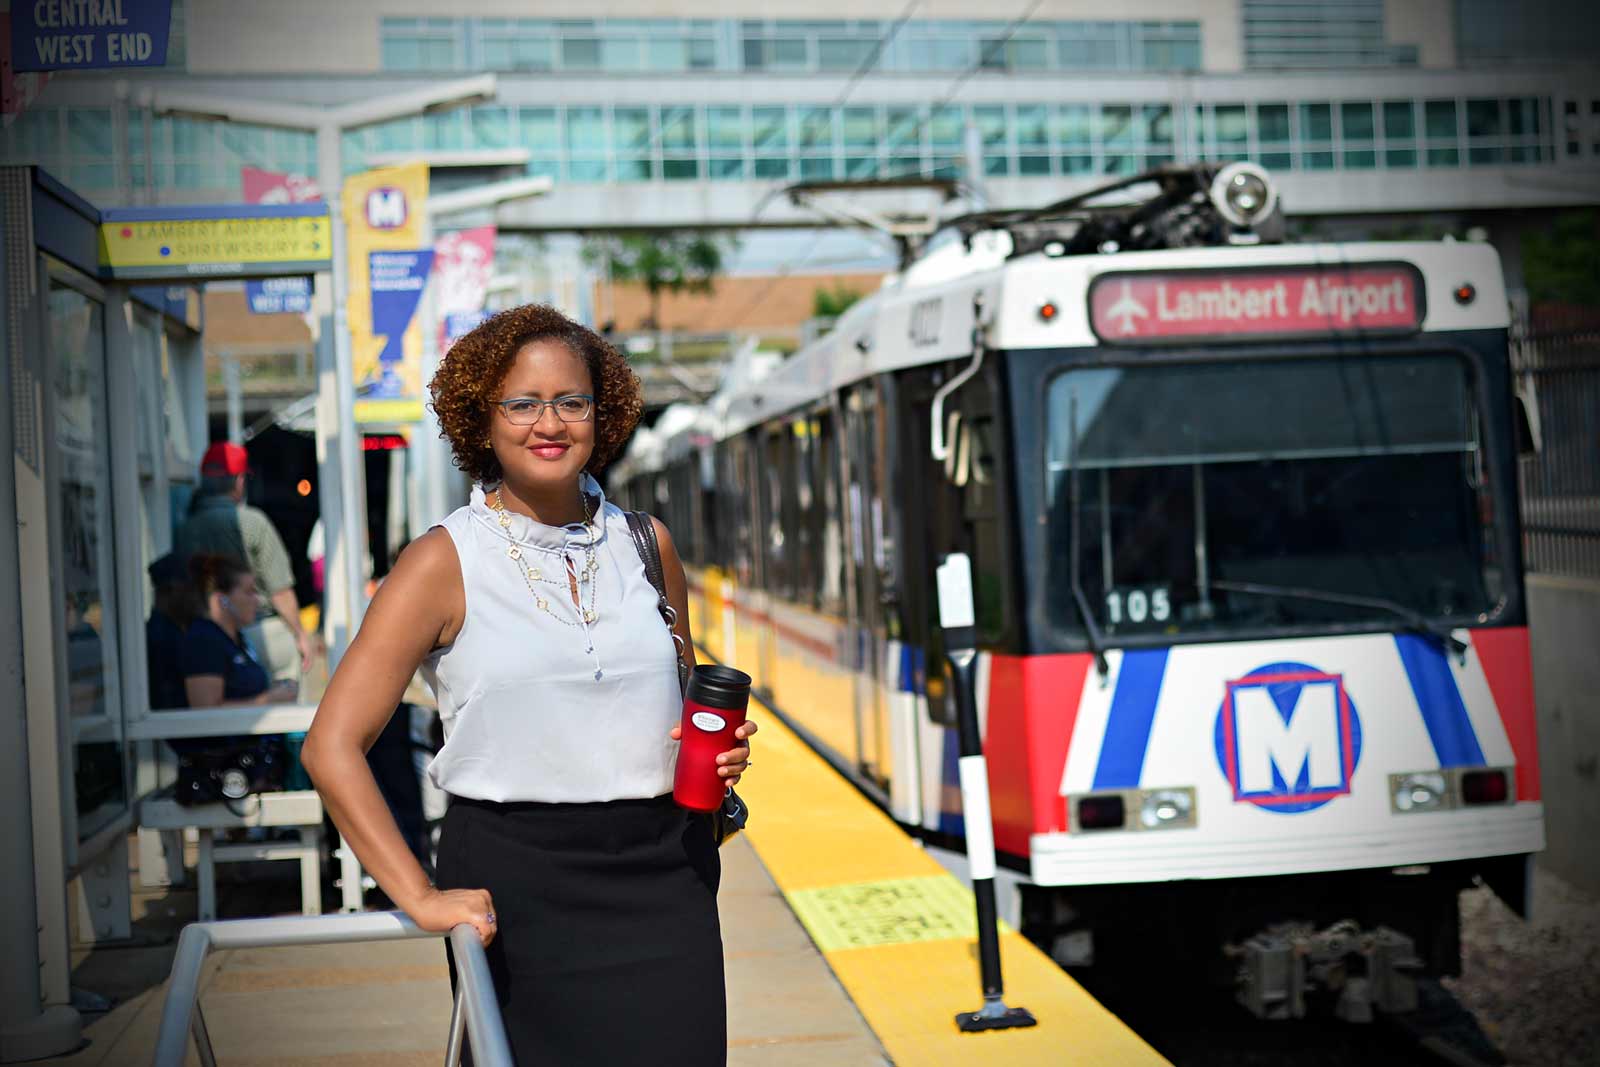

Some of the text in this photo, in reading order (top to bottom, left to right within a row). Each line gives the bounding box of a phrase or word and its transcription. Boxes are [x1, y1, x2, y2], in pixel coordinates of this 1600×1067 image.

[34, 0, 128, 27] CENTRAL
[35, 33, 153, 65] WEST END
[137, 219, 299, 241] LAMBERT AIRPORT
[175, 241, 300, 257] SHREWSBURY
[1156, 276, 1407, 322] Lambert Airport
[1105, 588, 1171, 624] 105
[1233, 682, 1343, 793] M
